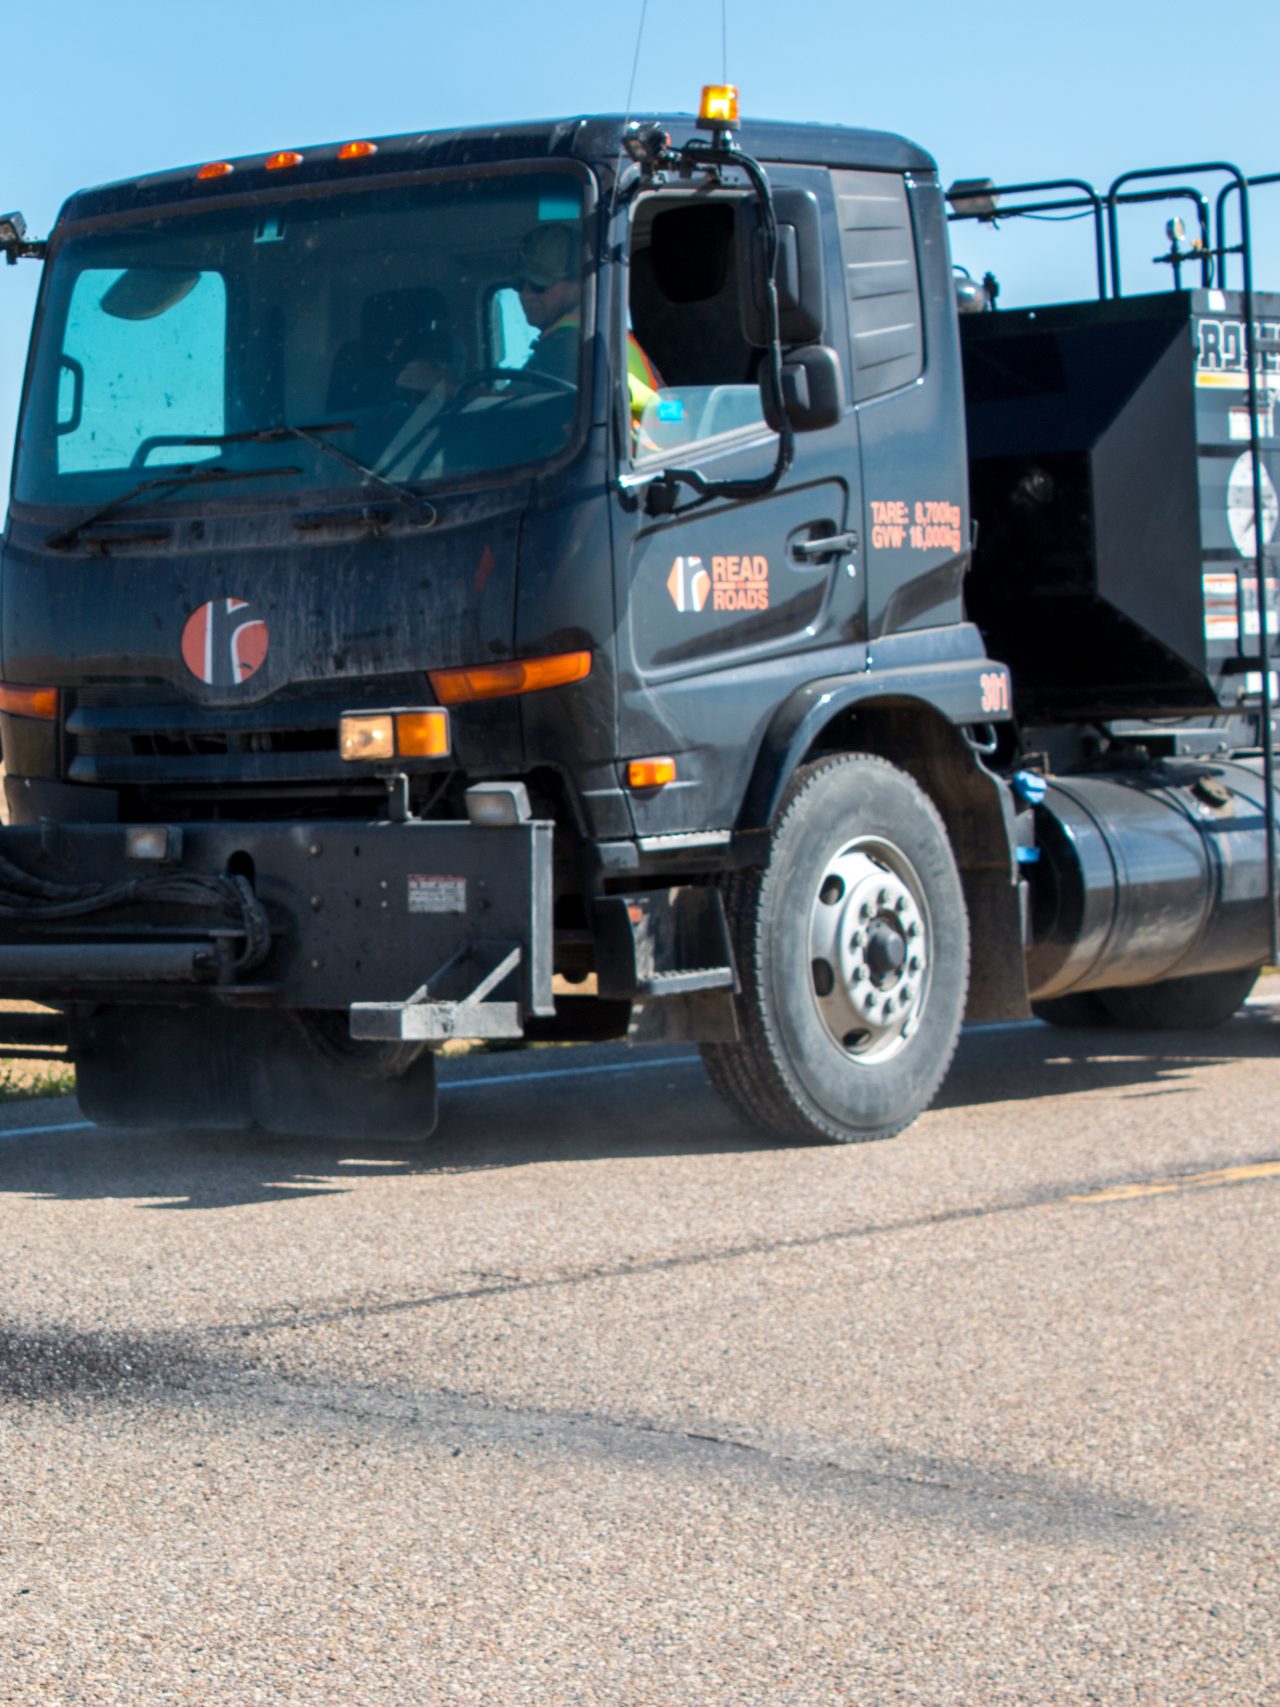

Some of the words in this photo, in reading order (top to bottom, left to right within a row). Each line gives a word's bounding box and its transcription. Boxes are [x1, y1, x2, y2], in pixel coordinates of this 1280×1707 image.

[870, 501, 909, 524] TARE:
[712, 555, 768, 582] READ
[713, 589, 769, 611] ROADS
